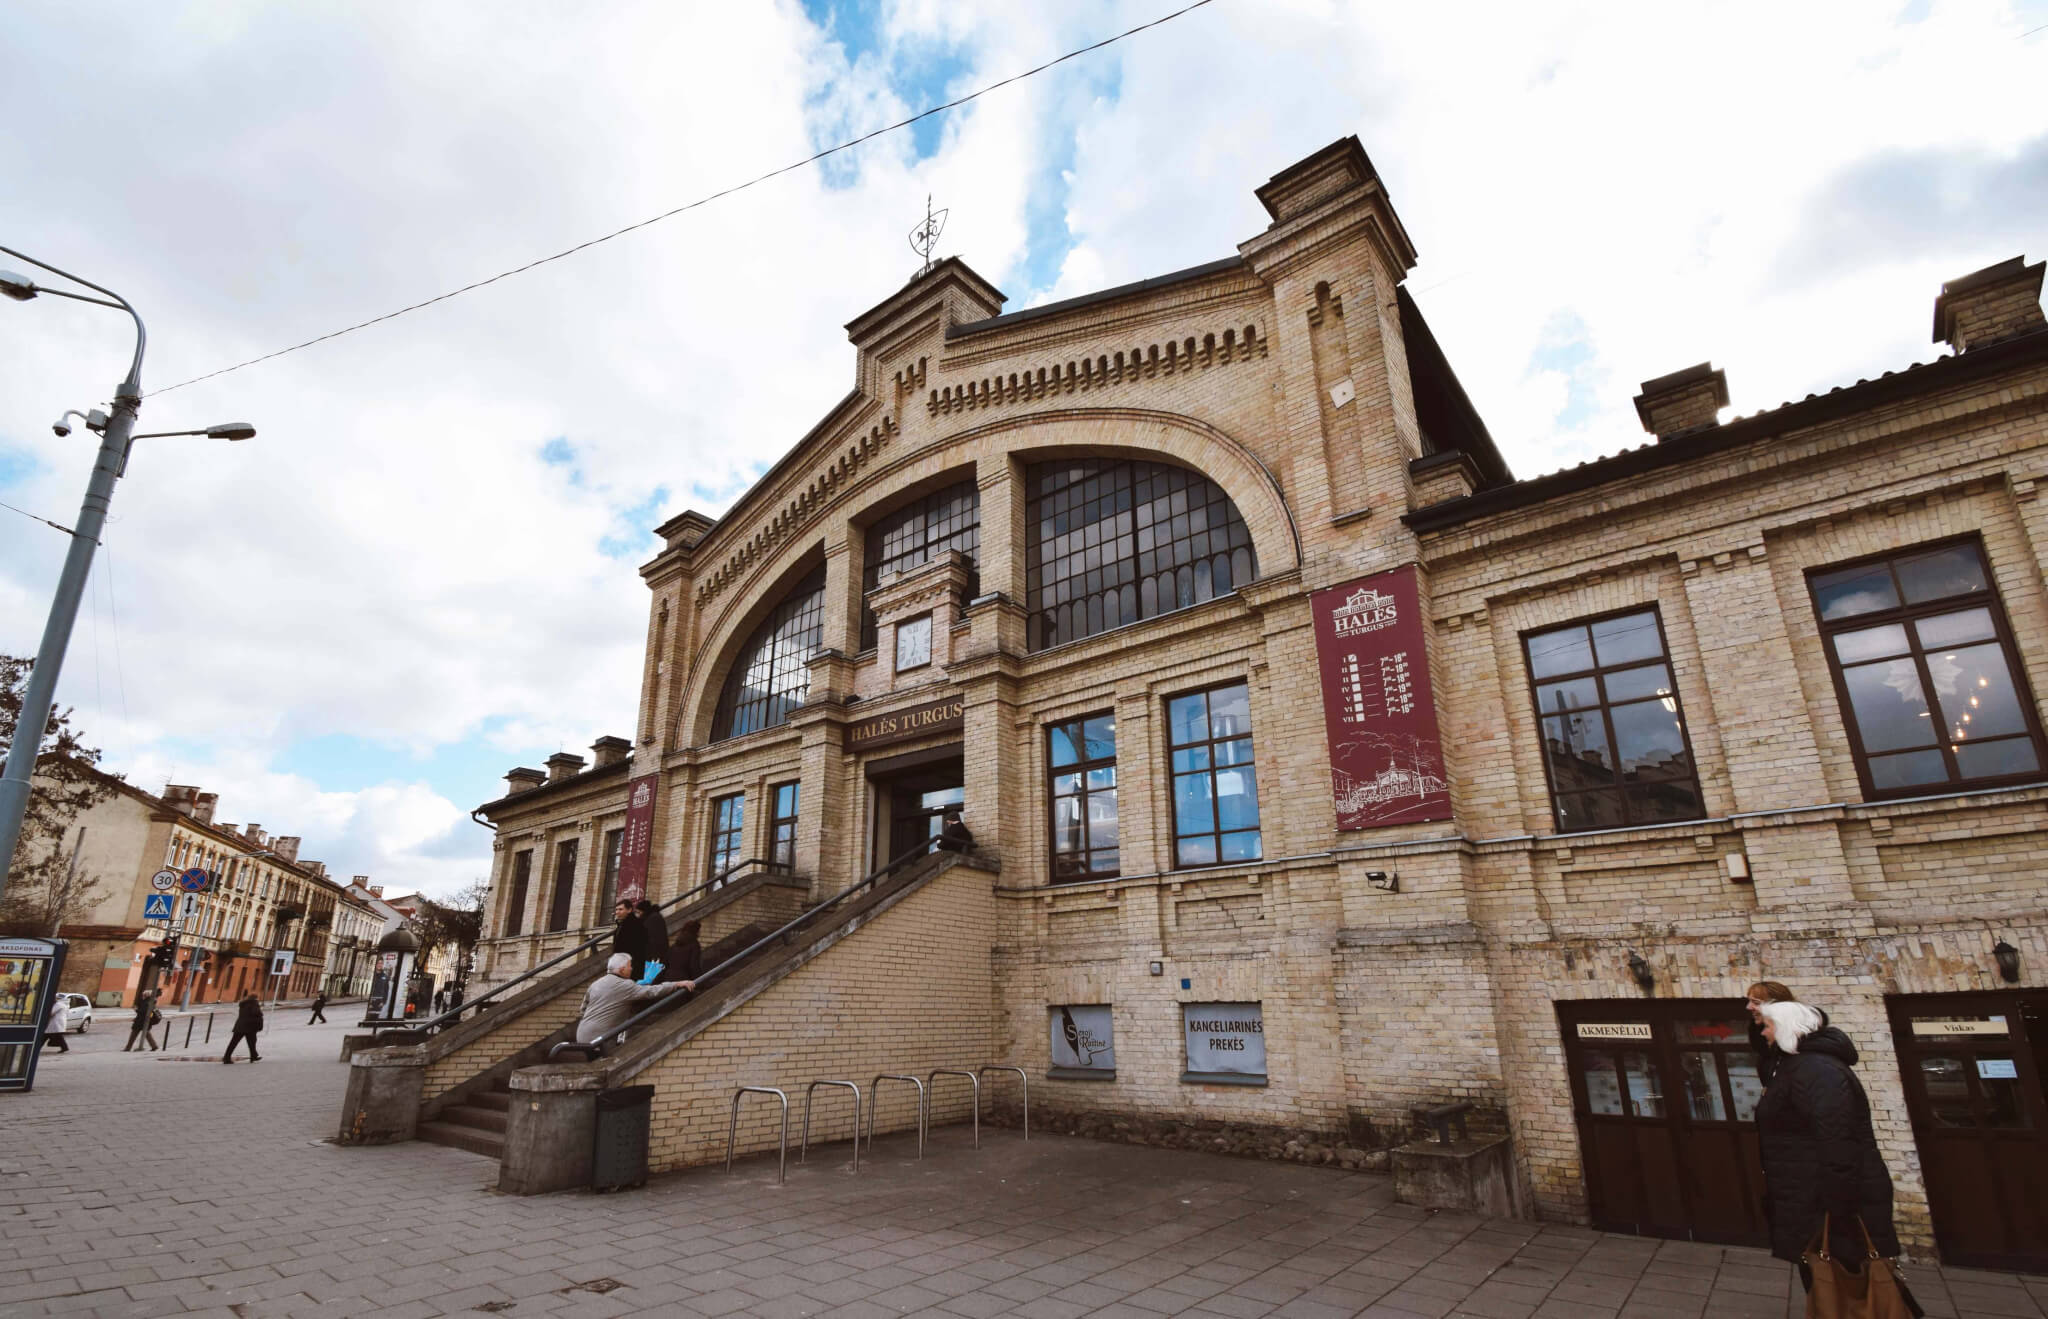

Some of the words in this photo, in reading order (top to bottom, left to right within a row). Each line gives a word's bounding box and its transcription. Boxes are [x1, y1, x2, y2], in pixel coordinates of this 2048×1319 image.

[1335, 606, 1397, 632] HALĖS
[1350, 623, 1384, 636] TURGUS
[851, 718, 897, 742] HALĖS
[902, 703, 963, 729] TURGUS
[156, 876, 172, 885] 30
[1190, 1019, 1263, 1034] KANCELIARINĖS
[1580, 1024, 1649, 1036] AKMENĖLIAI
[1943, 1024, 1976, 1033] Viskas
[1209, 1036, 1245, 1051] PREKĖS
